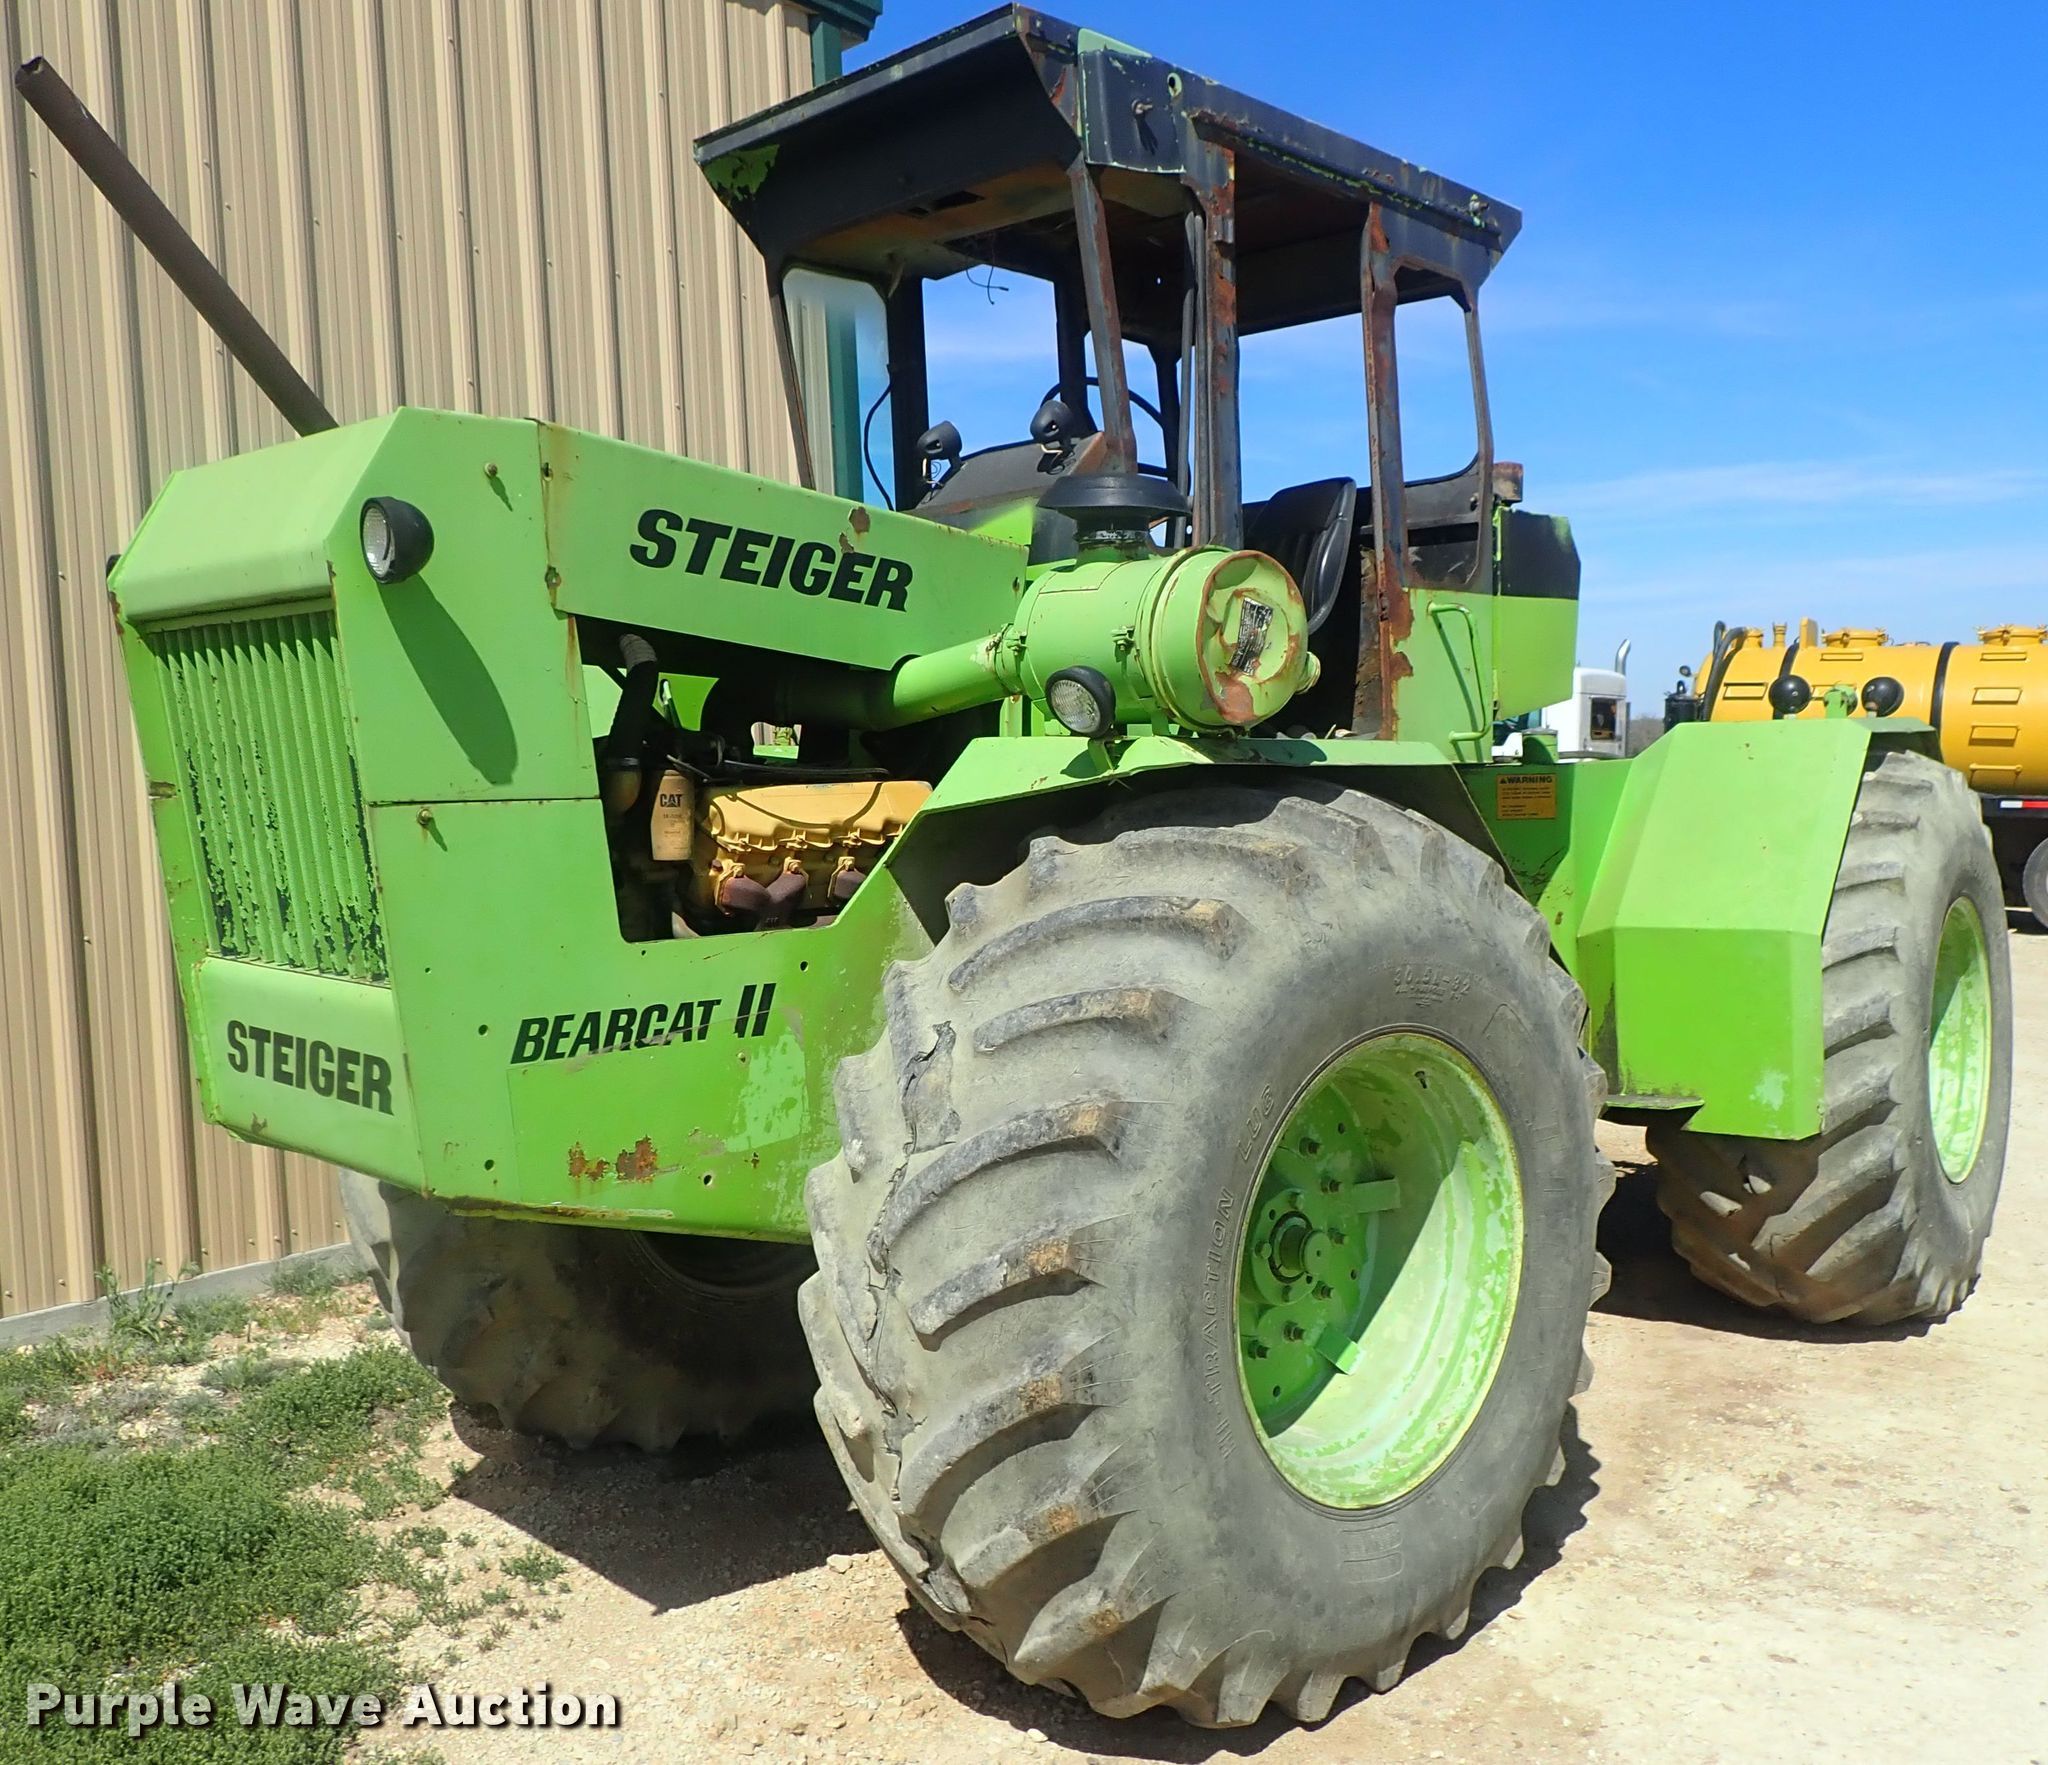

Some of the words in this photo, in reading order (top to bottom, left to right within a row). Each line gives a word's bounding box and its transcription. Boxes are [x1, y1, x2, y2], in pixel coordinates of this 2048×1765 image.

[629, 509, 913, 612] STEIGER
[660, 794, 682, 808] CAT
[1507, 776, 1553, 784] WARNING
[510, 998, 721, 1064] BEARCAT
[734, 982, 777, 1039] II
[227, 1020, 395, 1116] STEIGER
